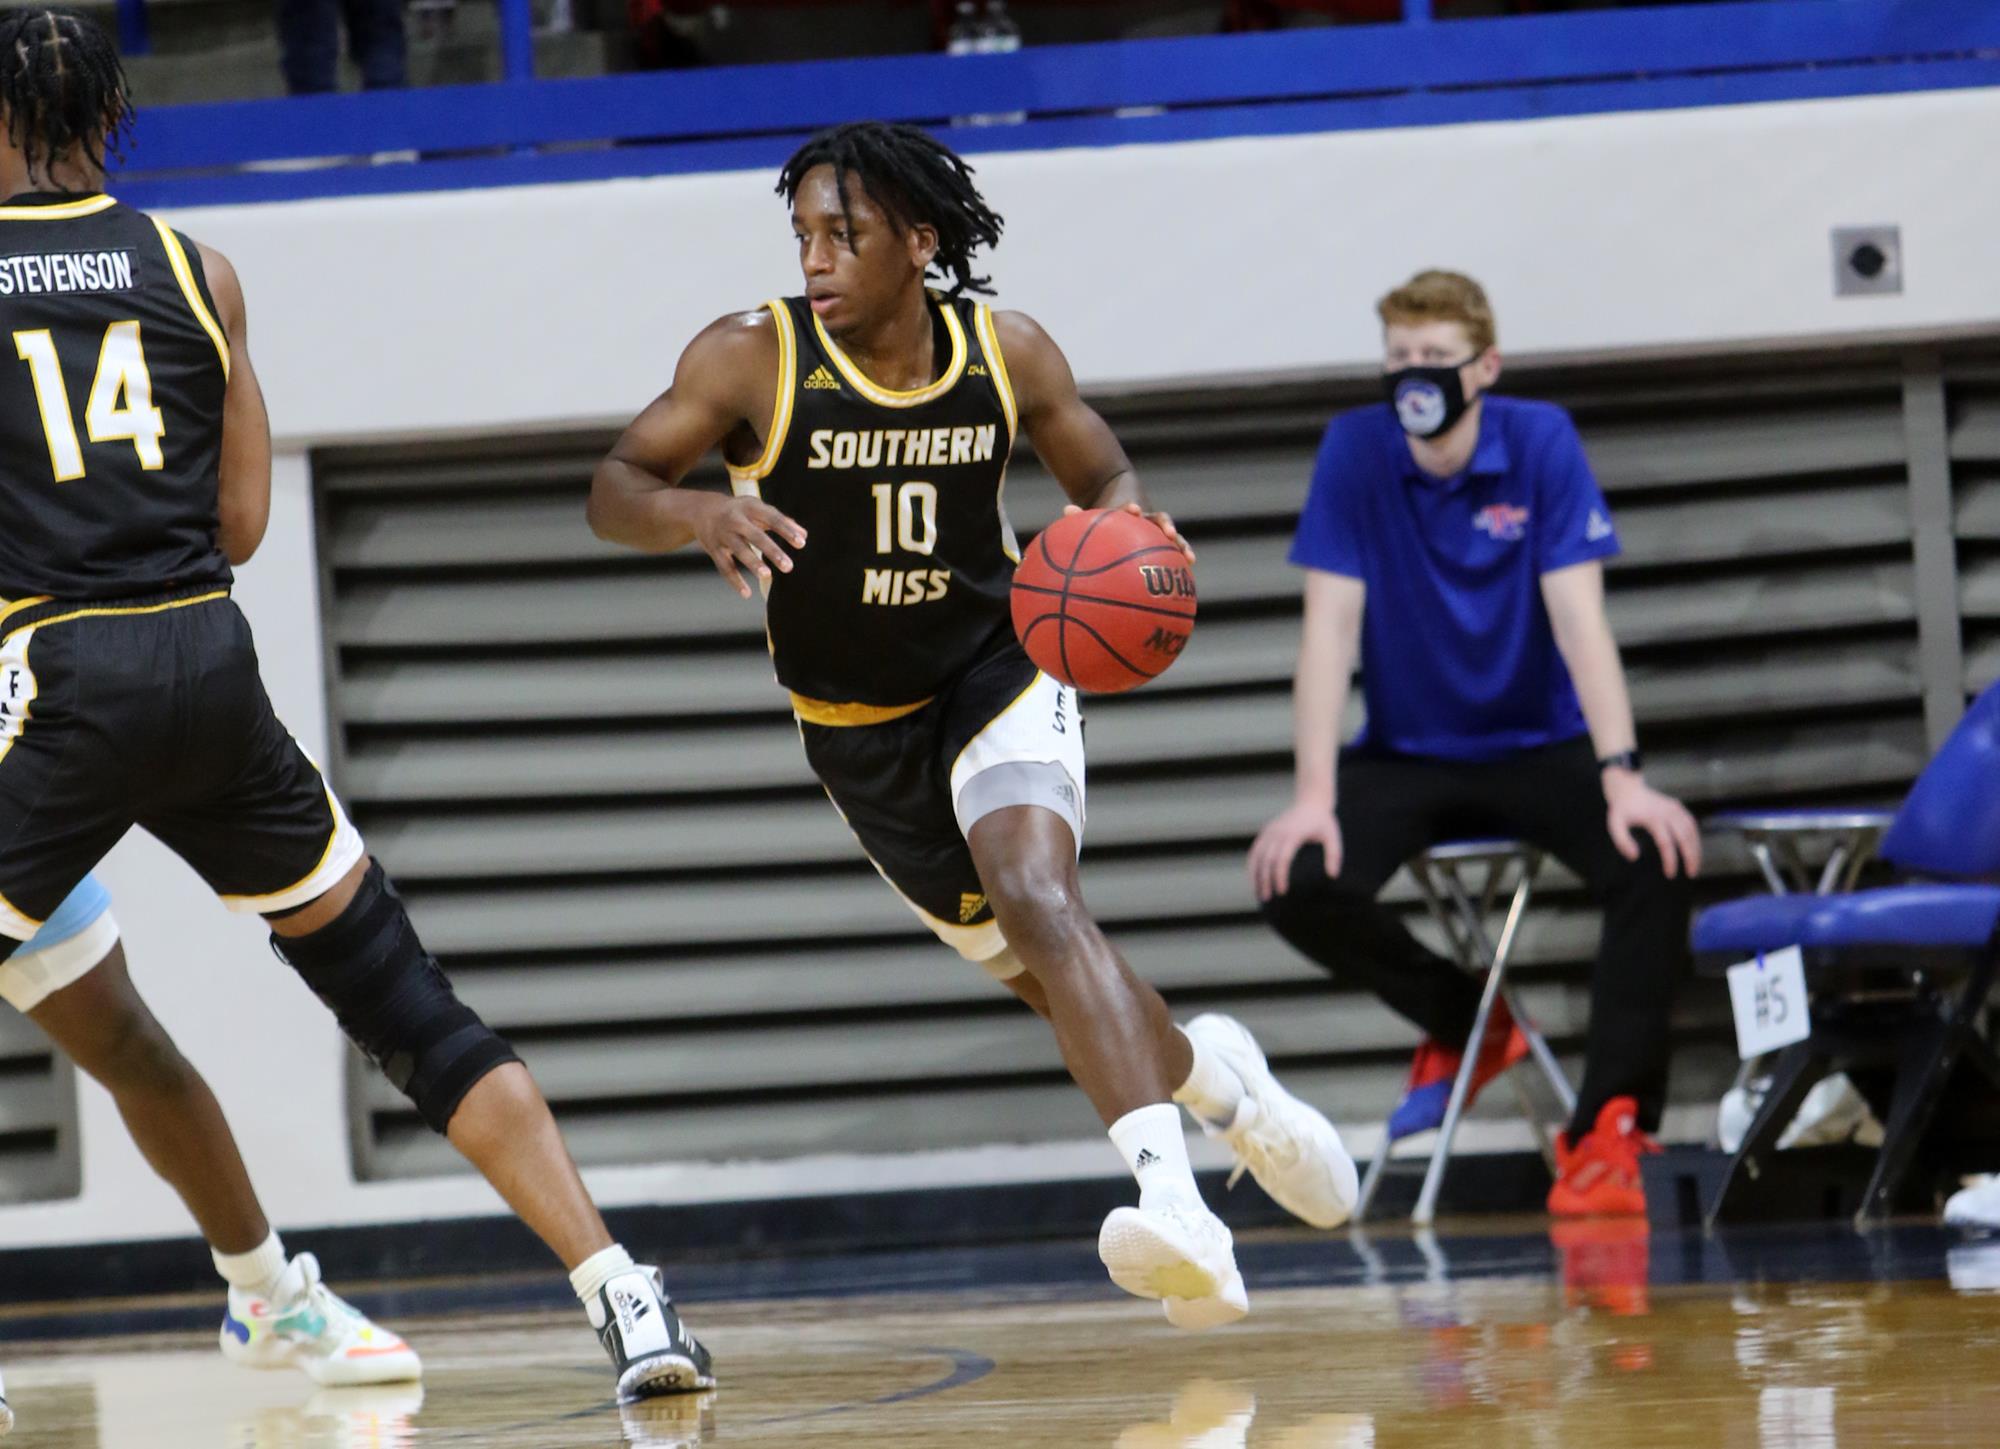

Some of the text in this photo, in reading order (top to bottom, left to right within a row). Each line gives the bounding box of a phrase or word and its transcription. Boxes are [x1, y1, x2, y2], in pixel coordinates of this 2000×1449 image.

[0, 251, 133, 295] STEVENSON
[12, 319, 166, 483] 14
[803, 379, 841, 390] adidas
[807, 424, 996, 469] SOUTHERN
[871, 481, 938, 556] 10
[861, 568, 951, 606] MISS
